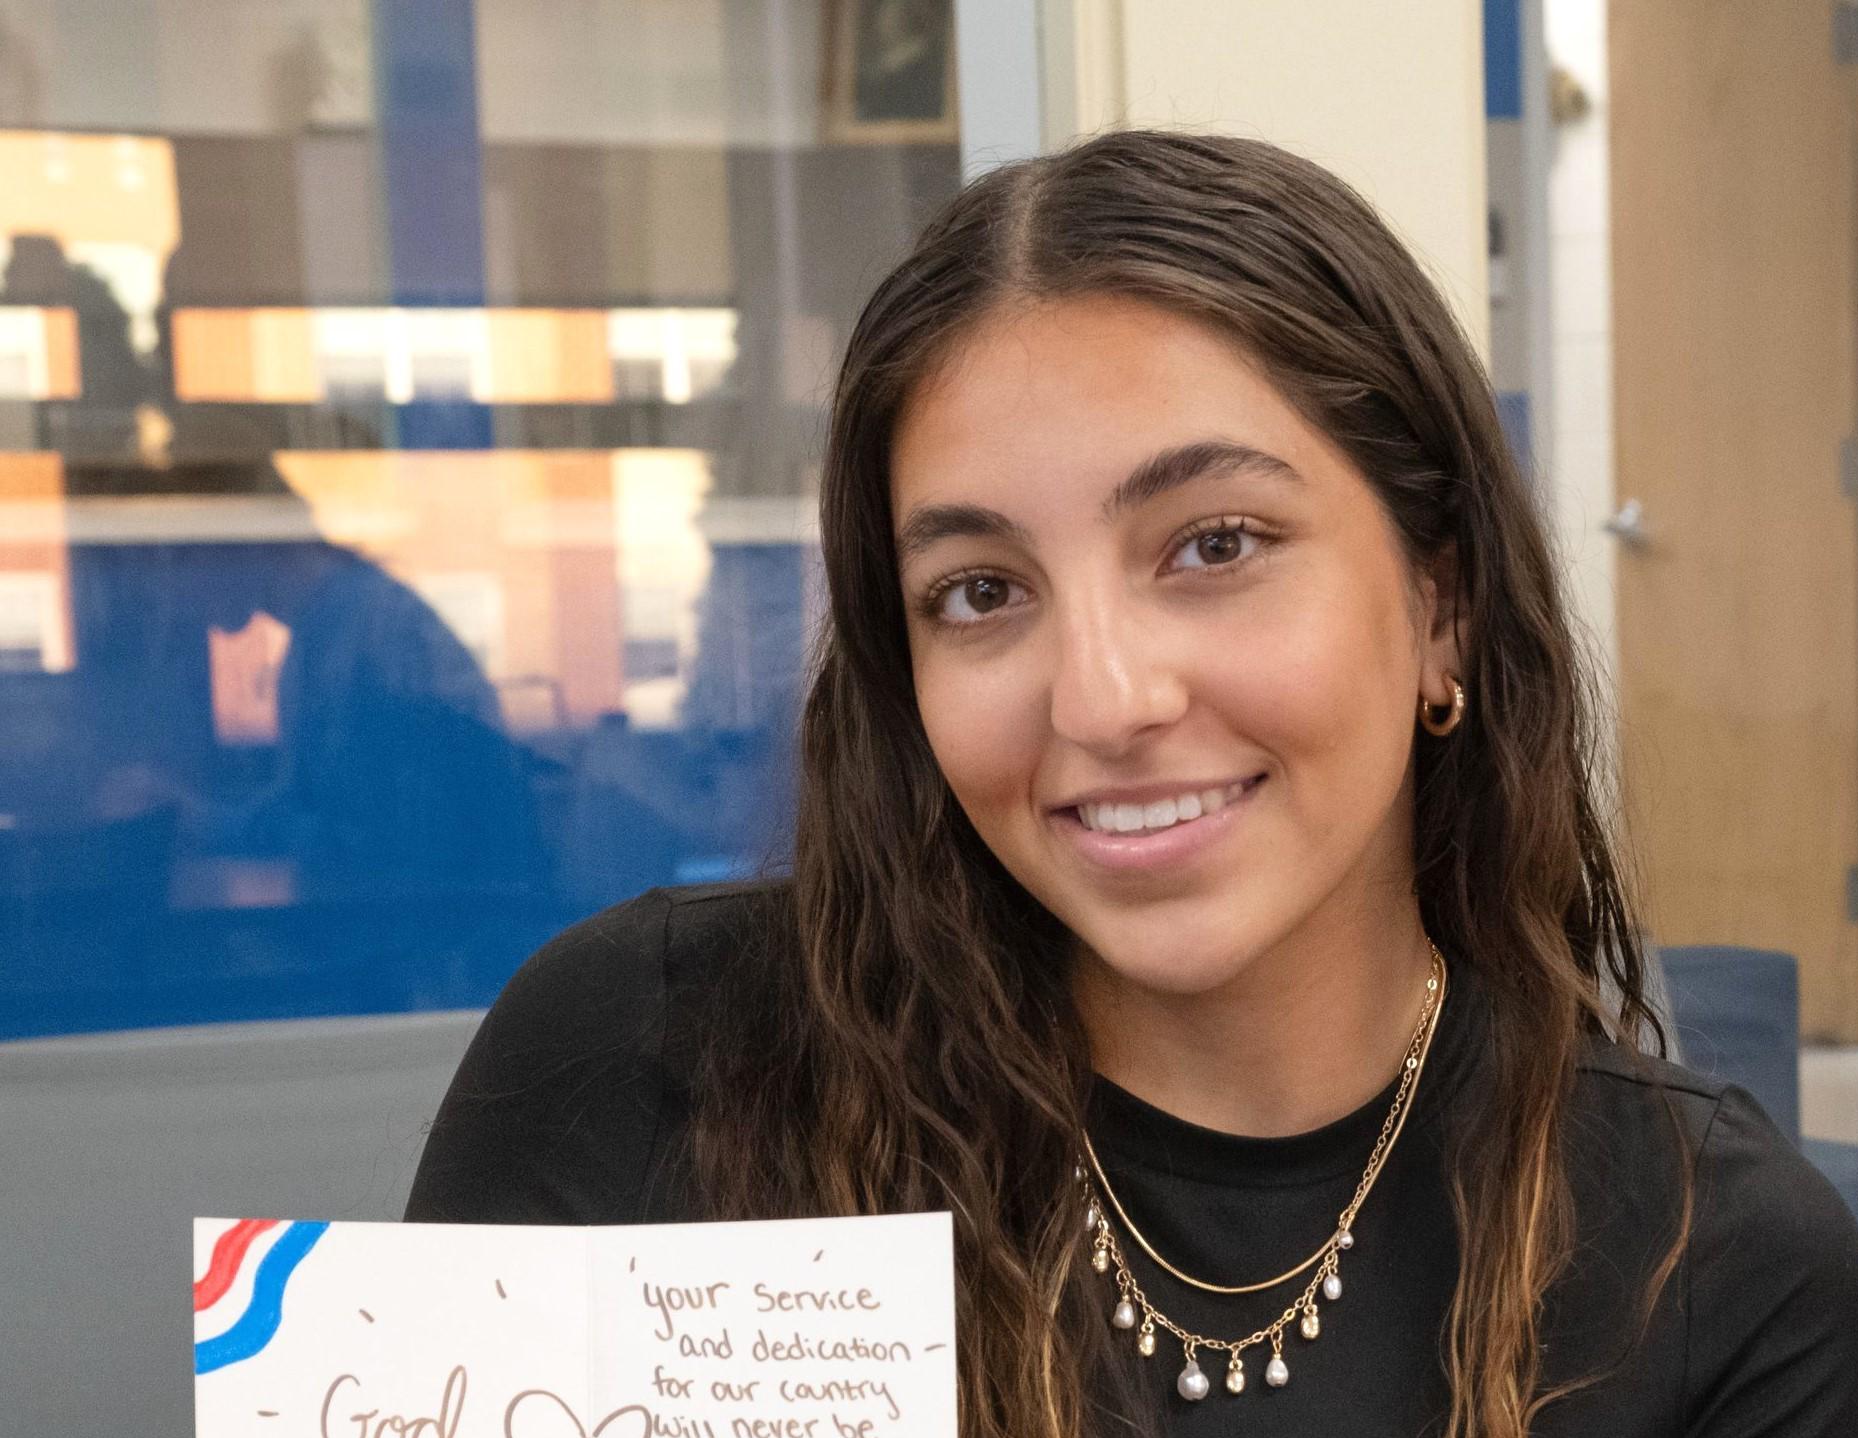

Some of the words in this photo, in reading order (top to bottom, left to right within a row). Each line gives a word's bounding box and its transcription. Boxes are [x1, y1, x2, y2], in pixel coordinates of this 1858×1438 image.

[680, 1328, 733, 1360] and
[752, 1329, 911, 1361] dedication
[652, 1365, 694, 1399] for
[711, 1379, 760, 1402] our
